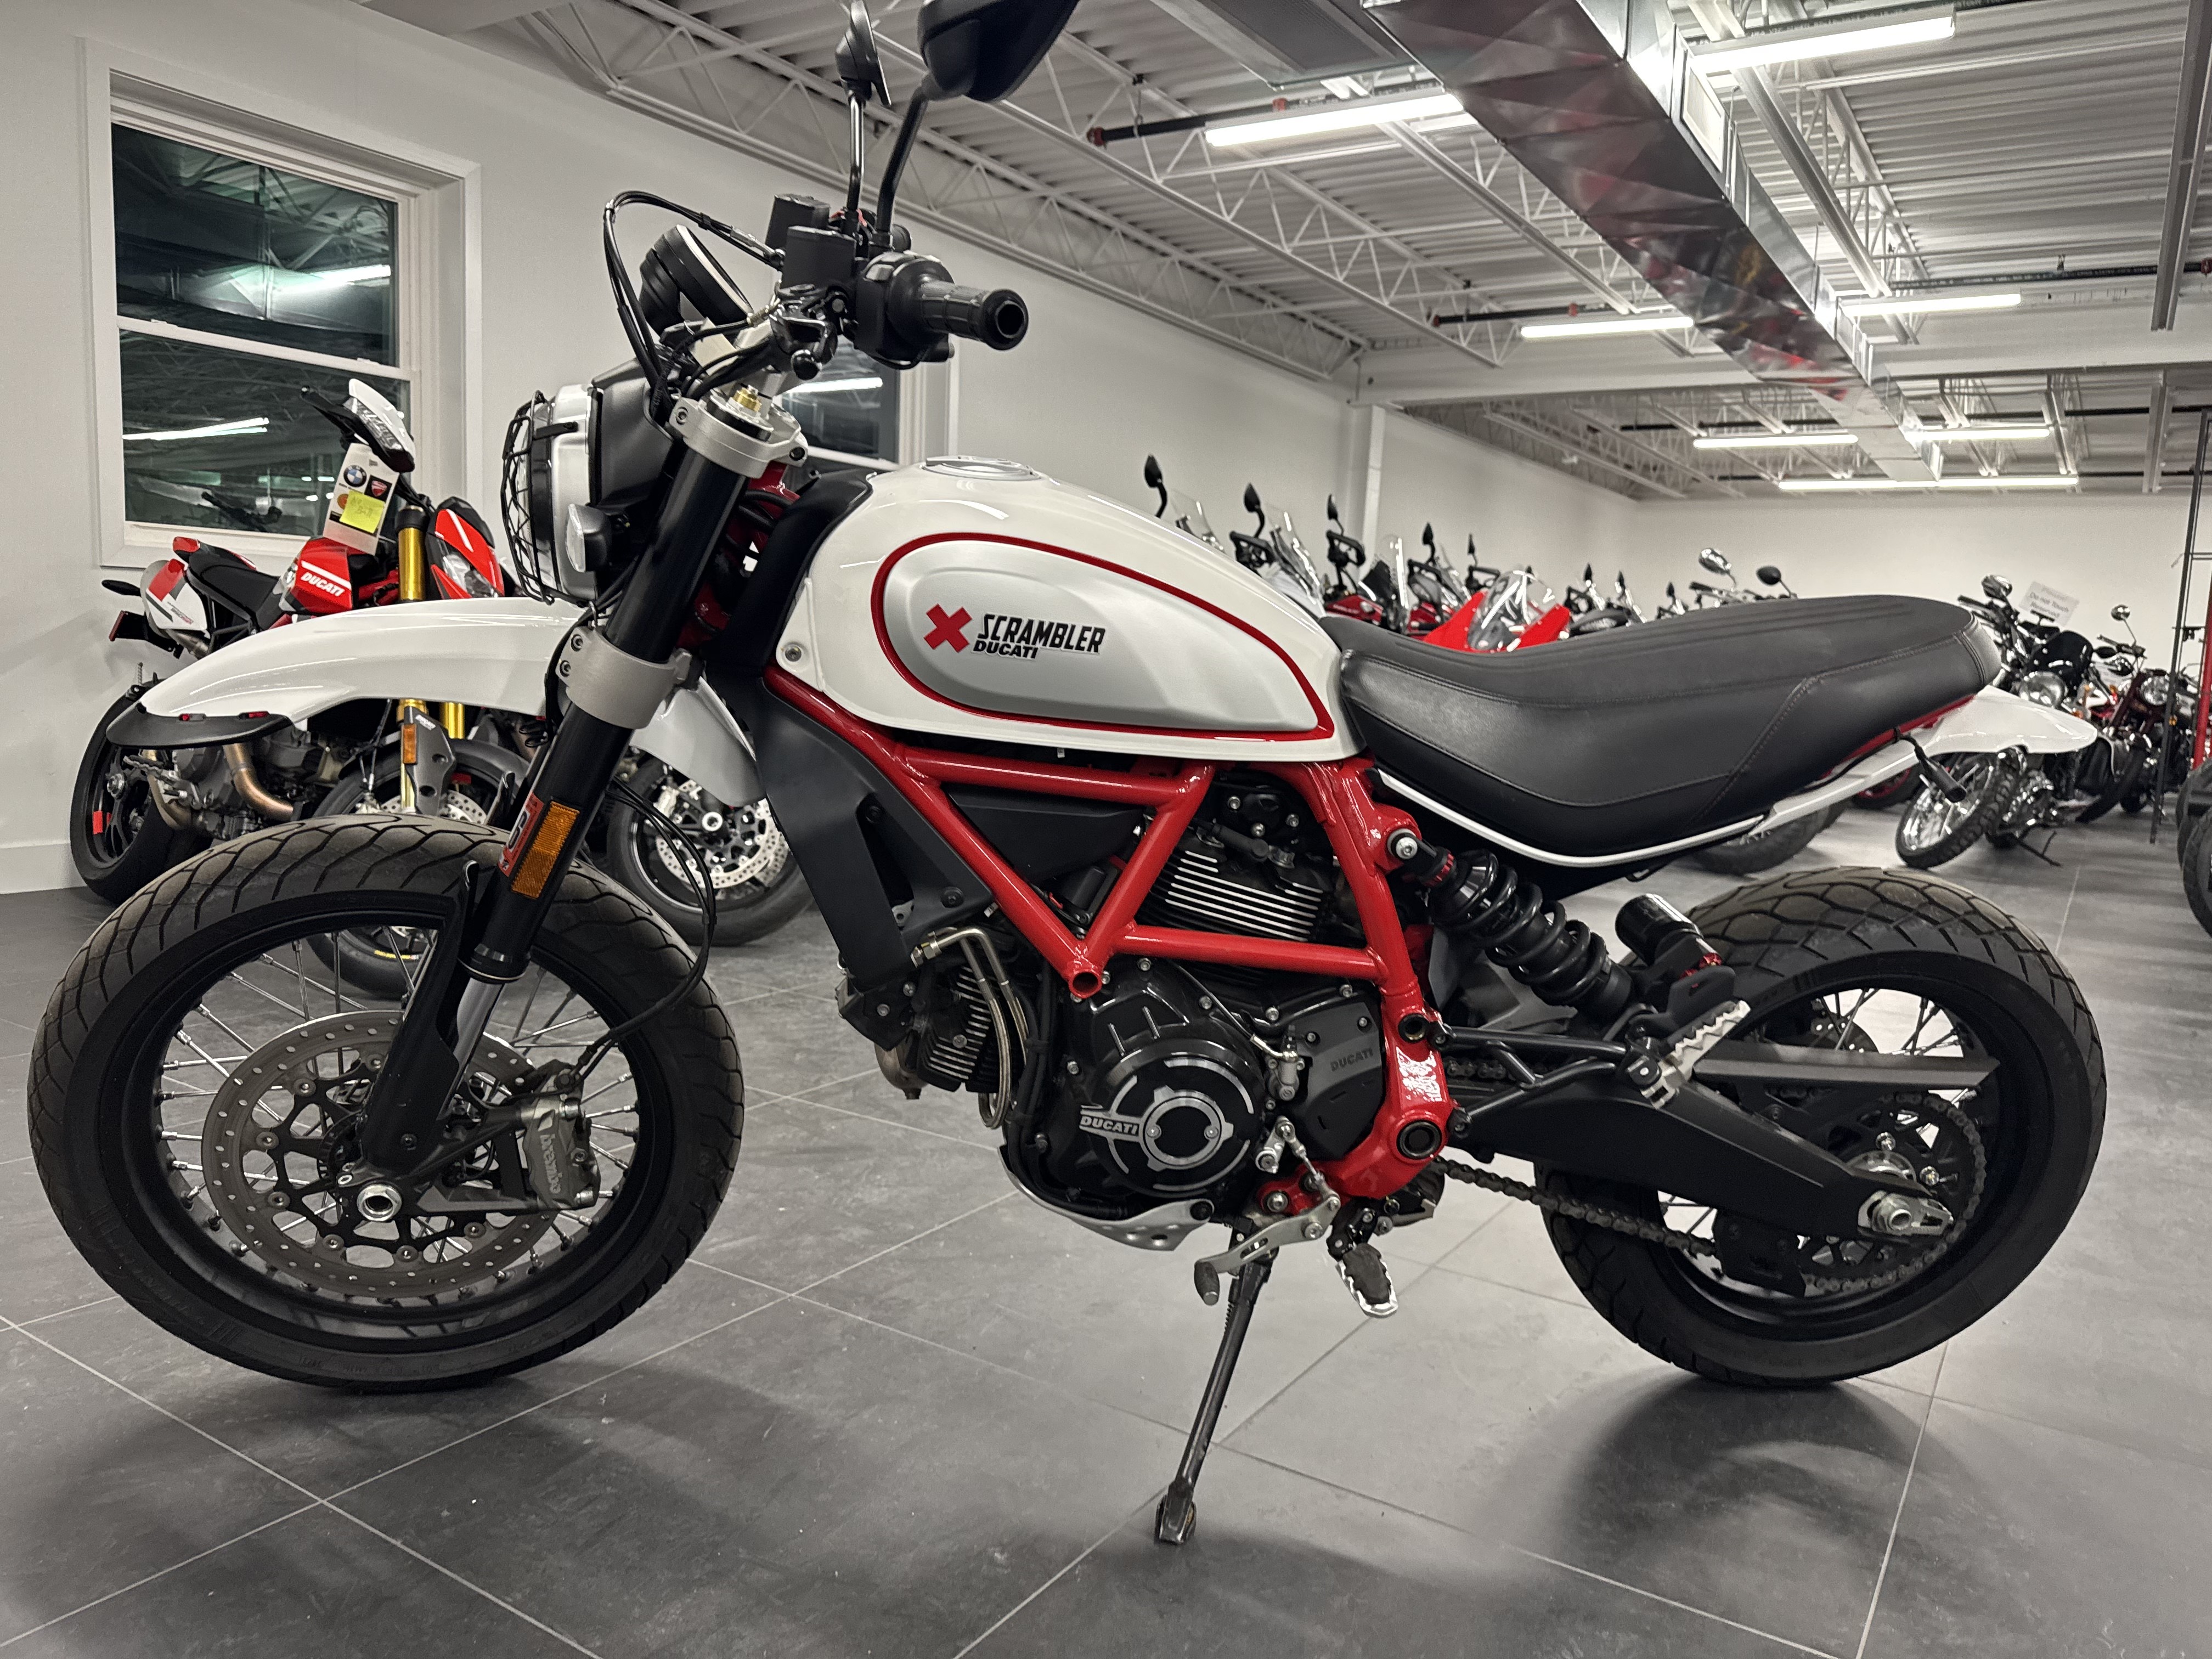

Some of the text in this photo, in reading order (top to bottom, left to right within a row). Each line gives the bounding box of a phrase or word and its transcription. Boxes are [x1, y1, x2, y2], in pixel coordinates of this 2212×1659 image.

[301, 572, 346, 597] DUCATI
[977, 613, 1106, 653] SCRAMBLER
[973, 639, 1039, 659] DUCATI
[1330, 1047, 1374, 1072] DUCATI
[1080, 1115, 1138, 1135] DUCATI
[539, 1134, 561, 1194] brembo
